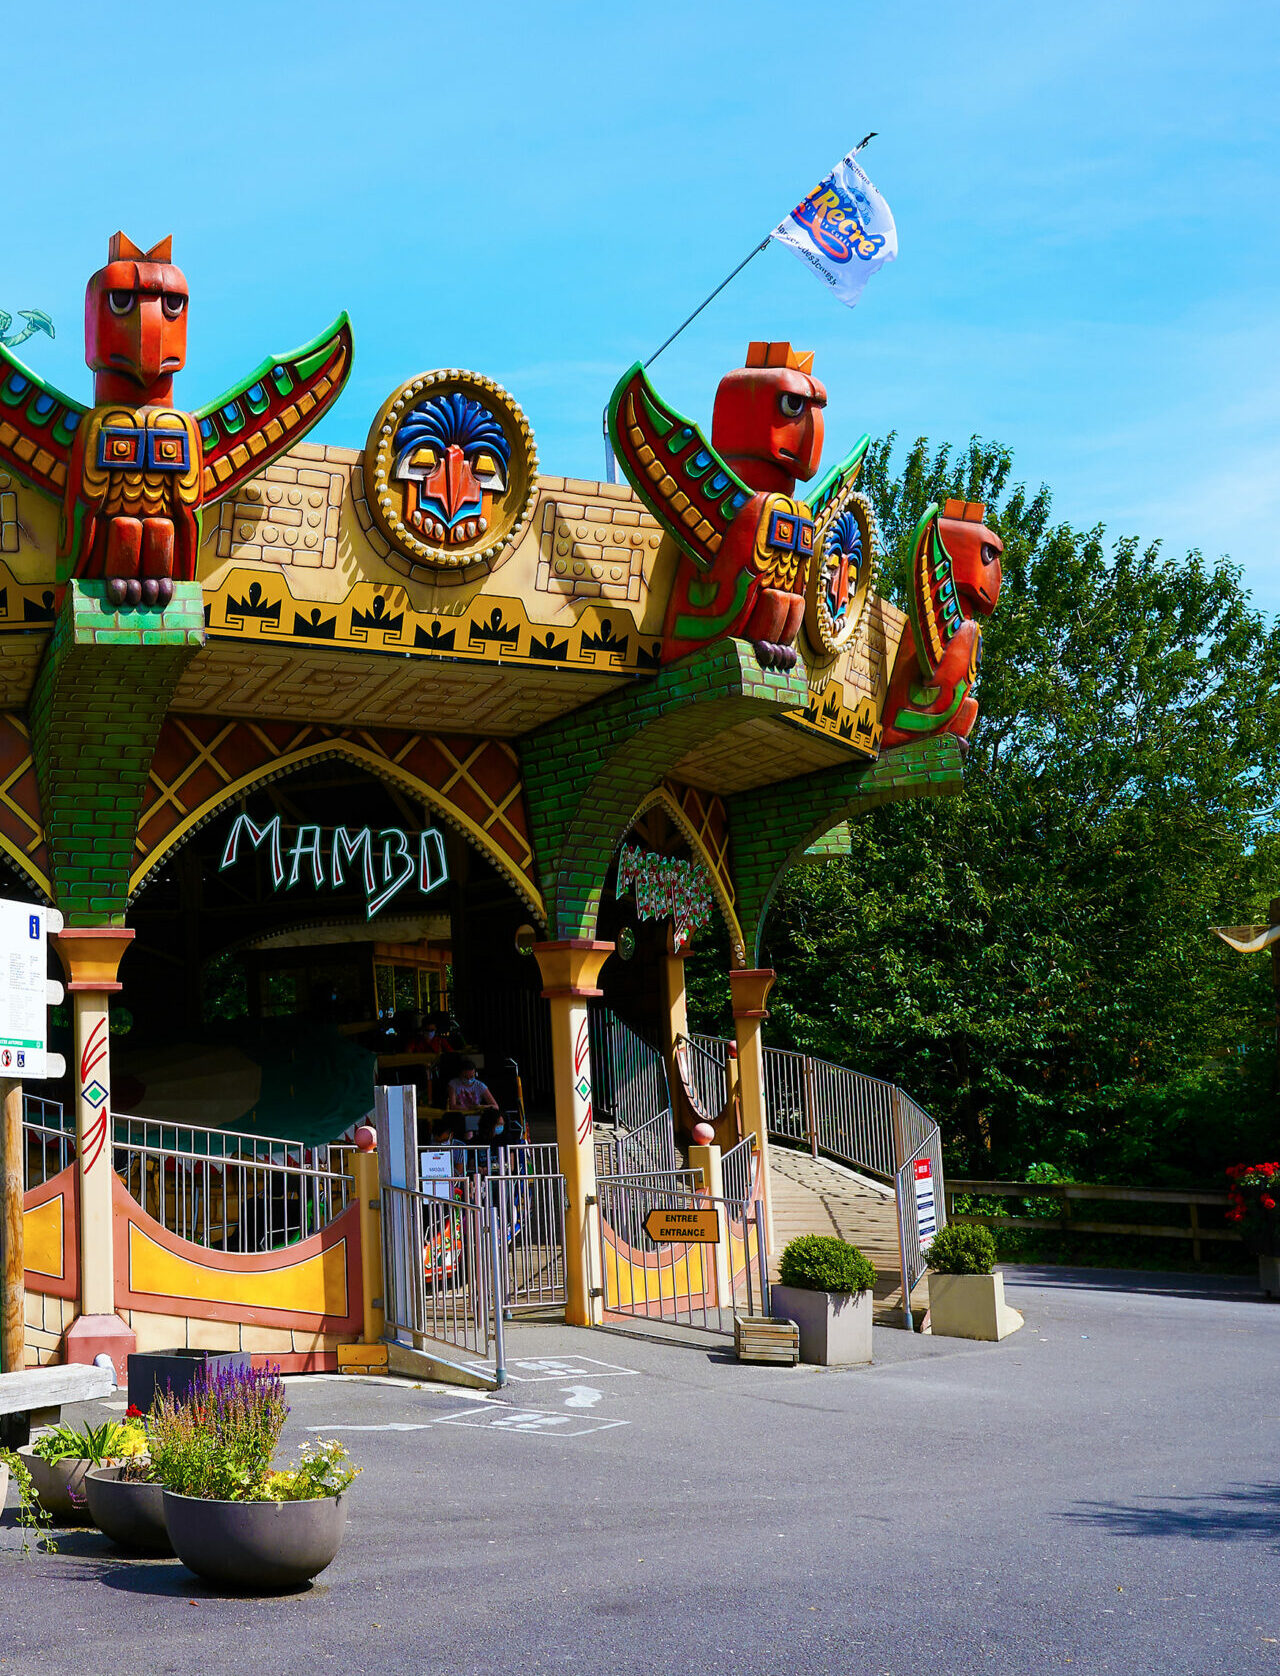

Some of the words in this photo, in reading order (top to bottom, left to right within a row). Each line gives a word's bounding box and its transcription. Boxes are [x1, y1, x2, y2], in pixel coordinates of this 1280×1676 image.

[218, 811, 450, 923] MAMBO
[665, 1214, 699, 1223] ENTREE
[659, 1228, 705, 1237] ENTRANCE
